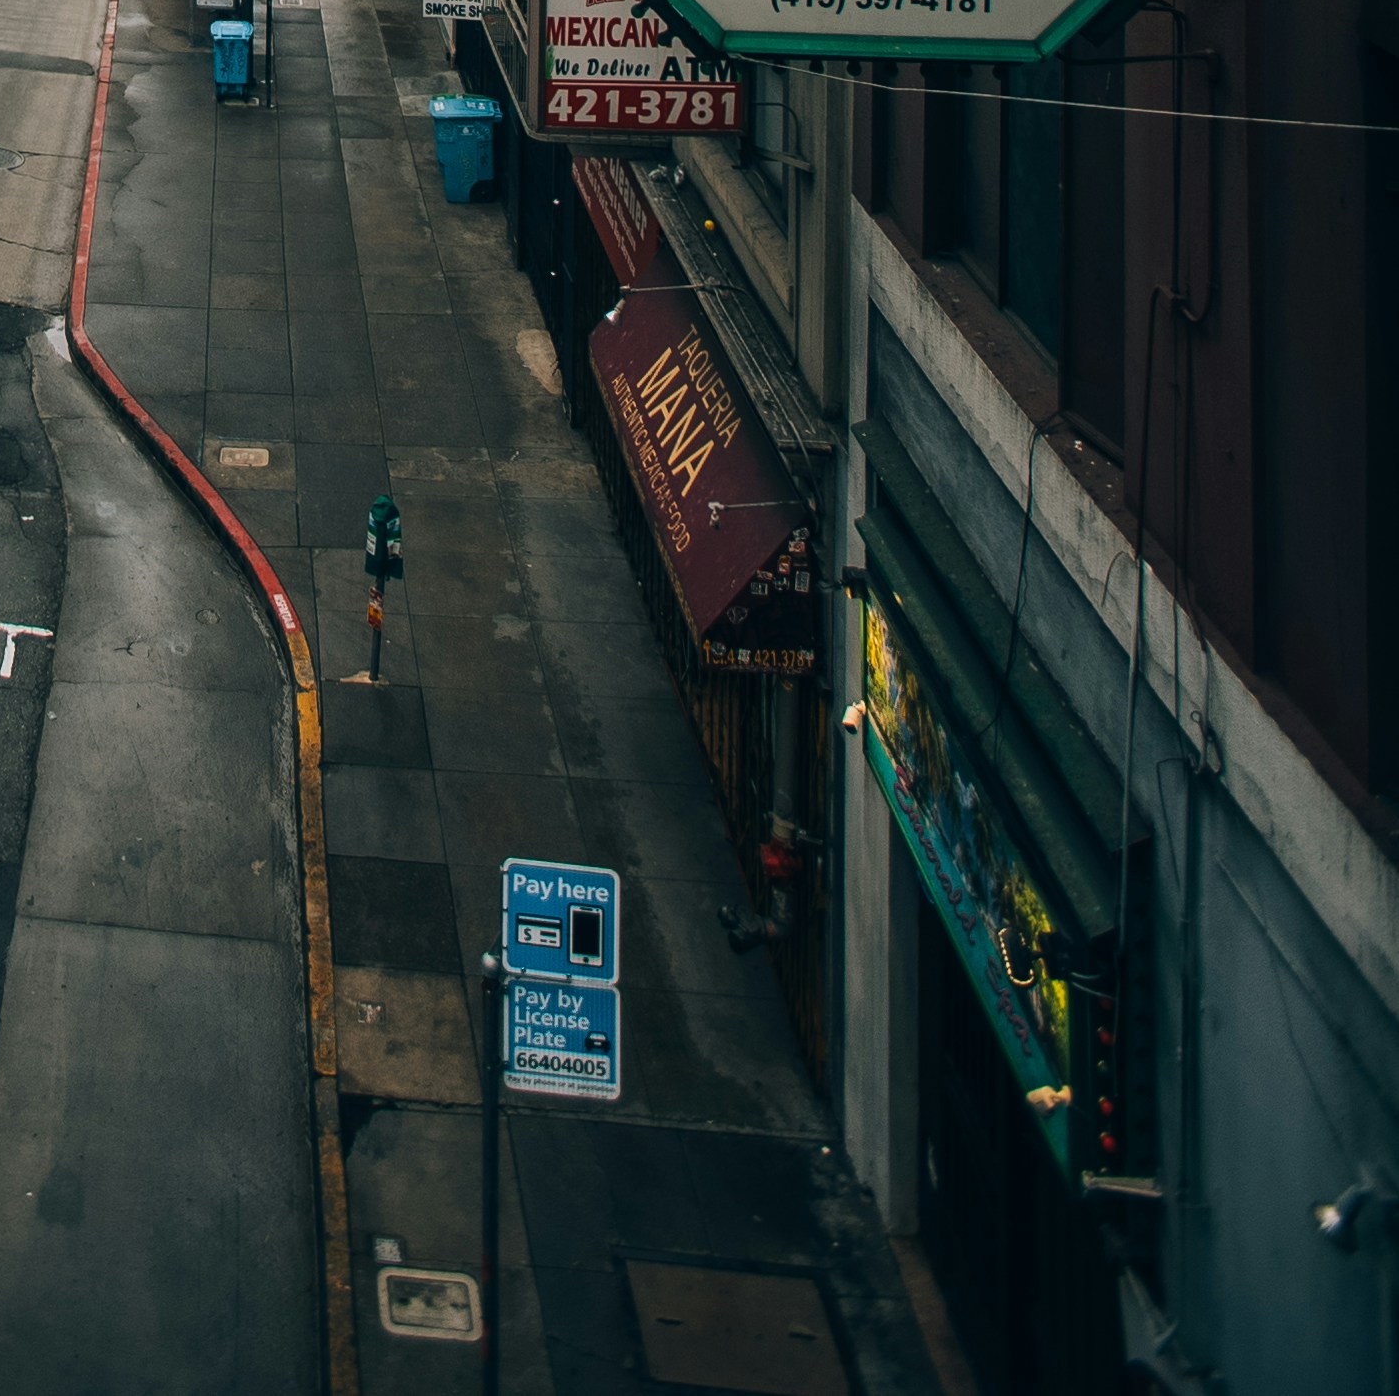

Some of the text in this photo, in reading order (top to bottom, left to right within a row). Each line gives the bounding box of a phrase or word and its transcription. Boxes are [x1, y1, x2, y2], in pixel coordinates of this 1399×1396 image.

[425, 3, 466, 17] SMOKE
[547, 16, 660, 48] MEXICAN
[555, 58, 650, 77] We Deliver
[660, 56, 739, 82] ATM
[547, 89, 737, 125] 421-3781
[677, 323, 742, 449] TAQUERIA
[611, 372, 648, 445] AUTHENTIC
[637, 347, 715, 497] MANA
[513, 873, 609, 902] Pay here
[515, 986, 584, 1013] Pay by
[515, 1005, 591, 1030] License
[515, 1027, 567, 1047] Plate
[517, 1053, 607, 1077] 66404005
